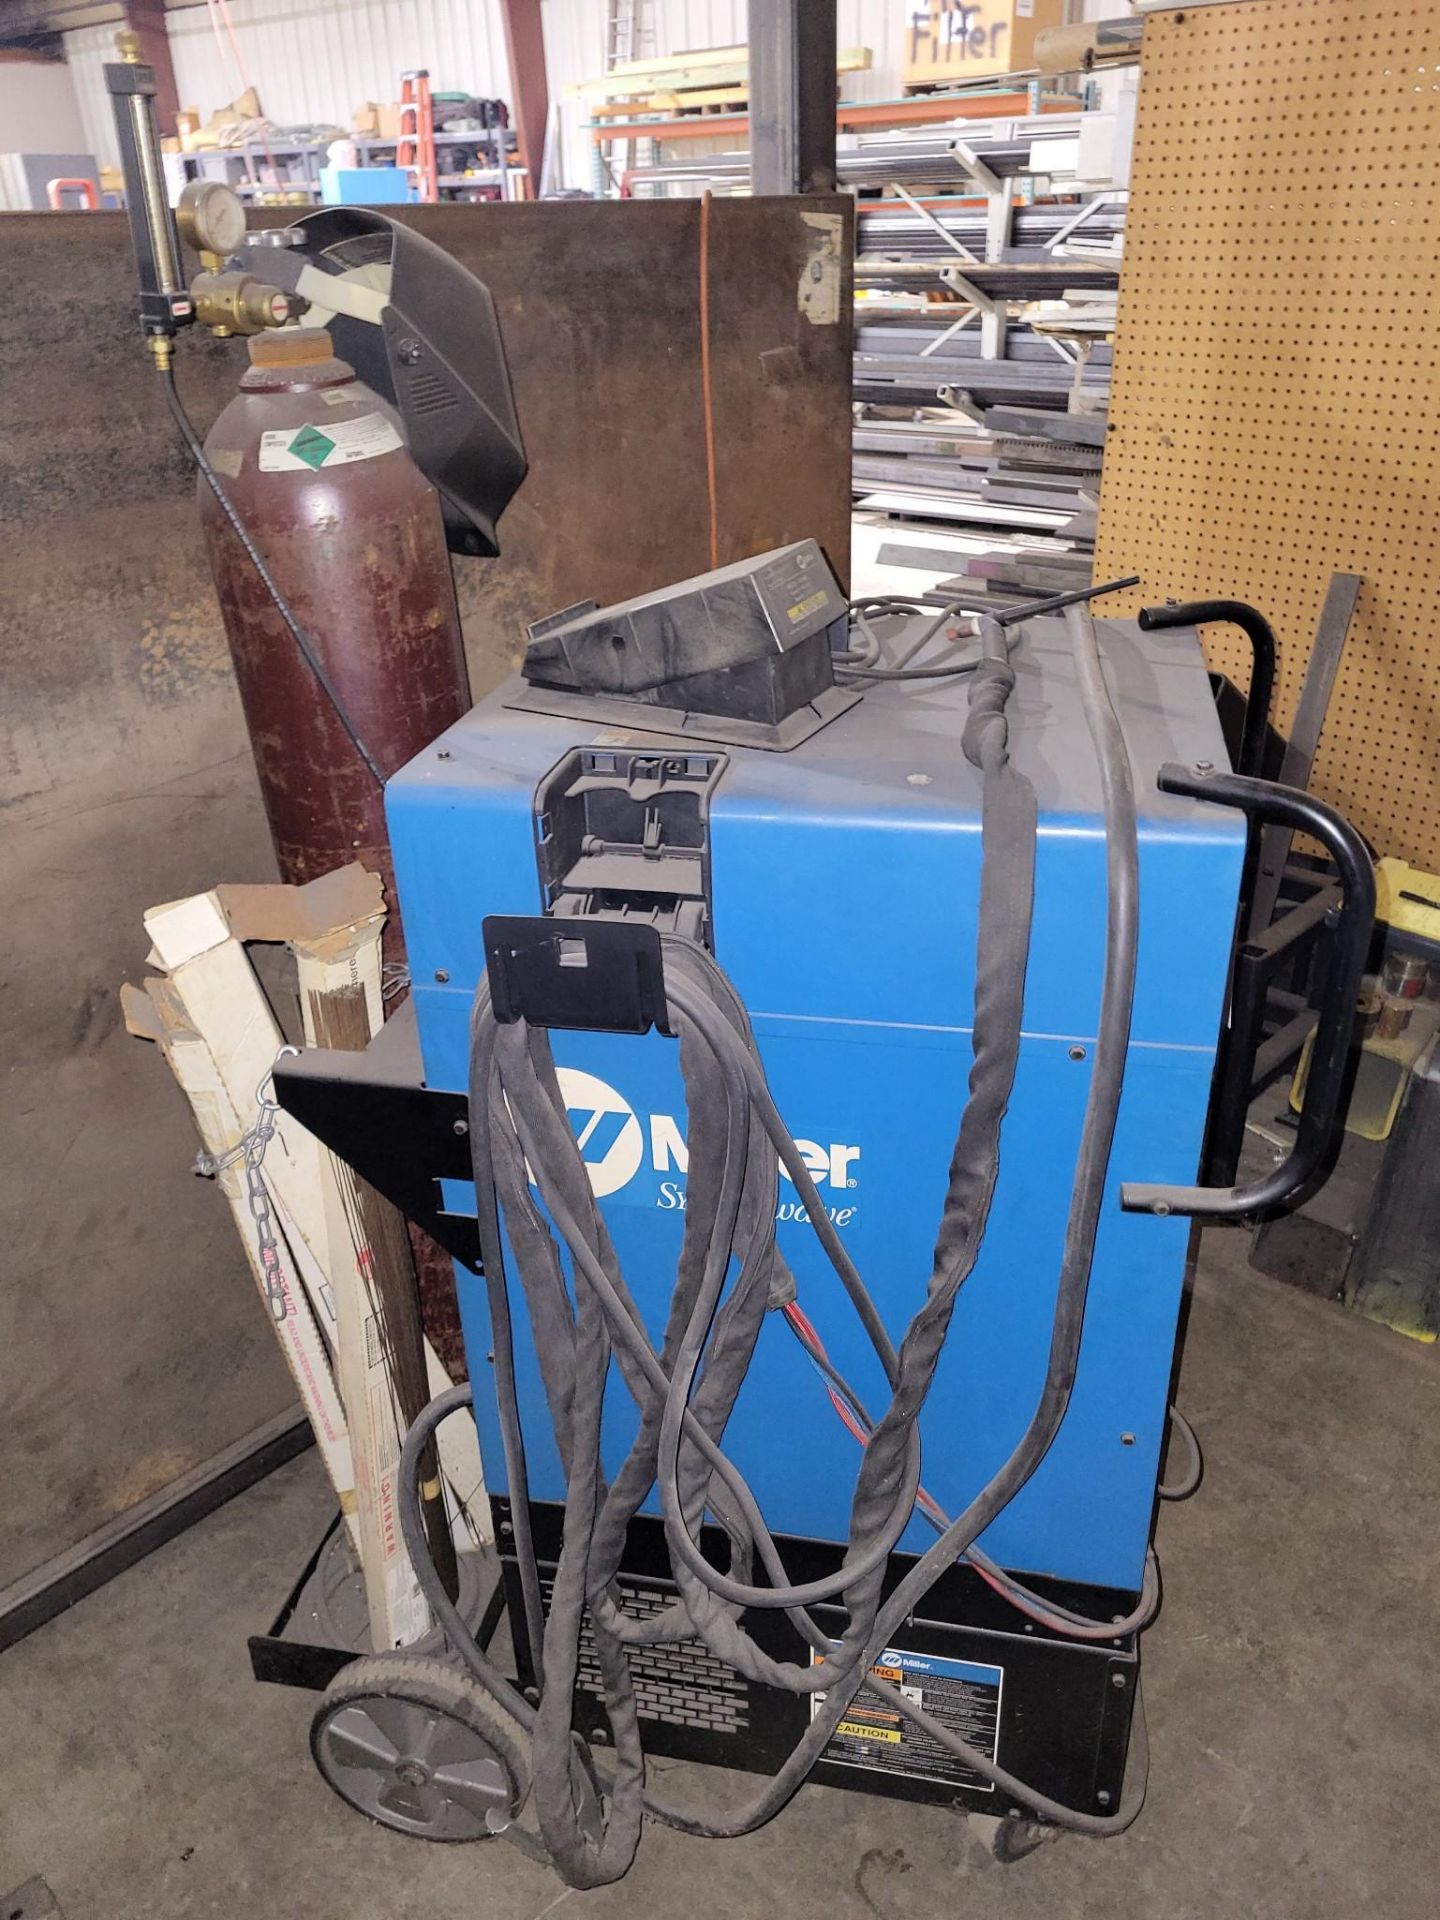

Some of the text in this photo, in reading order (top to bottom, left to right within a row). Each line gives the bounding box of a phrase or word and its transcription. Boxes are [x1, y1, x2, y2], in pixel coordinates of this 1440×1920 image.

[911, 11, 1008, 63] Filter
[649, 1114, 861, 1188] Mer
[903, 1658, 931, 1670] Miller
[836, 1723, 889, 1739] CAUTION
